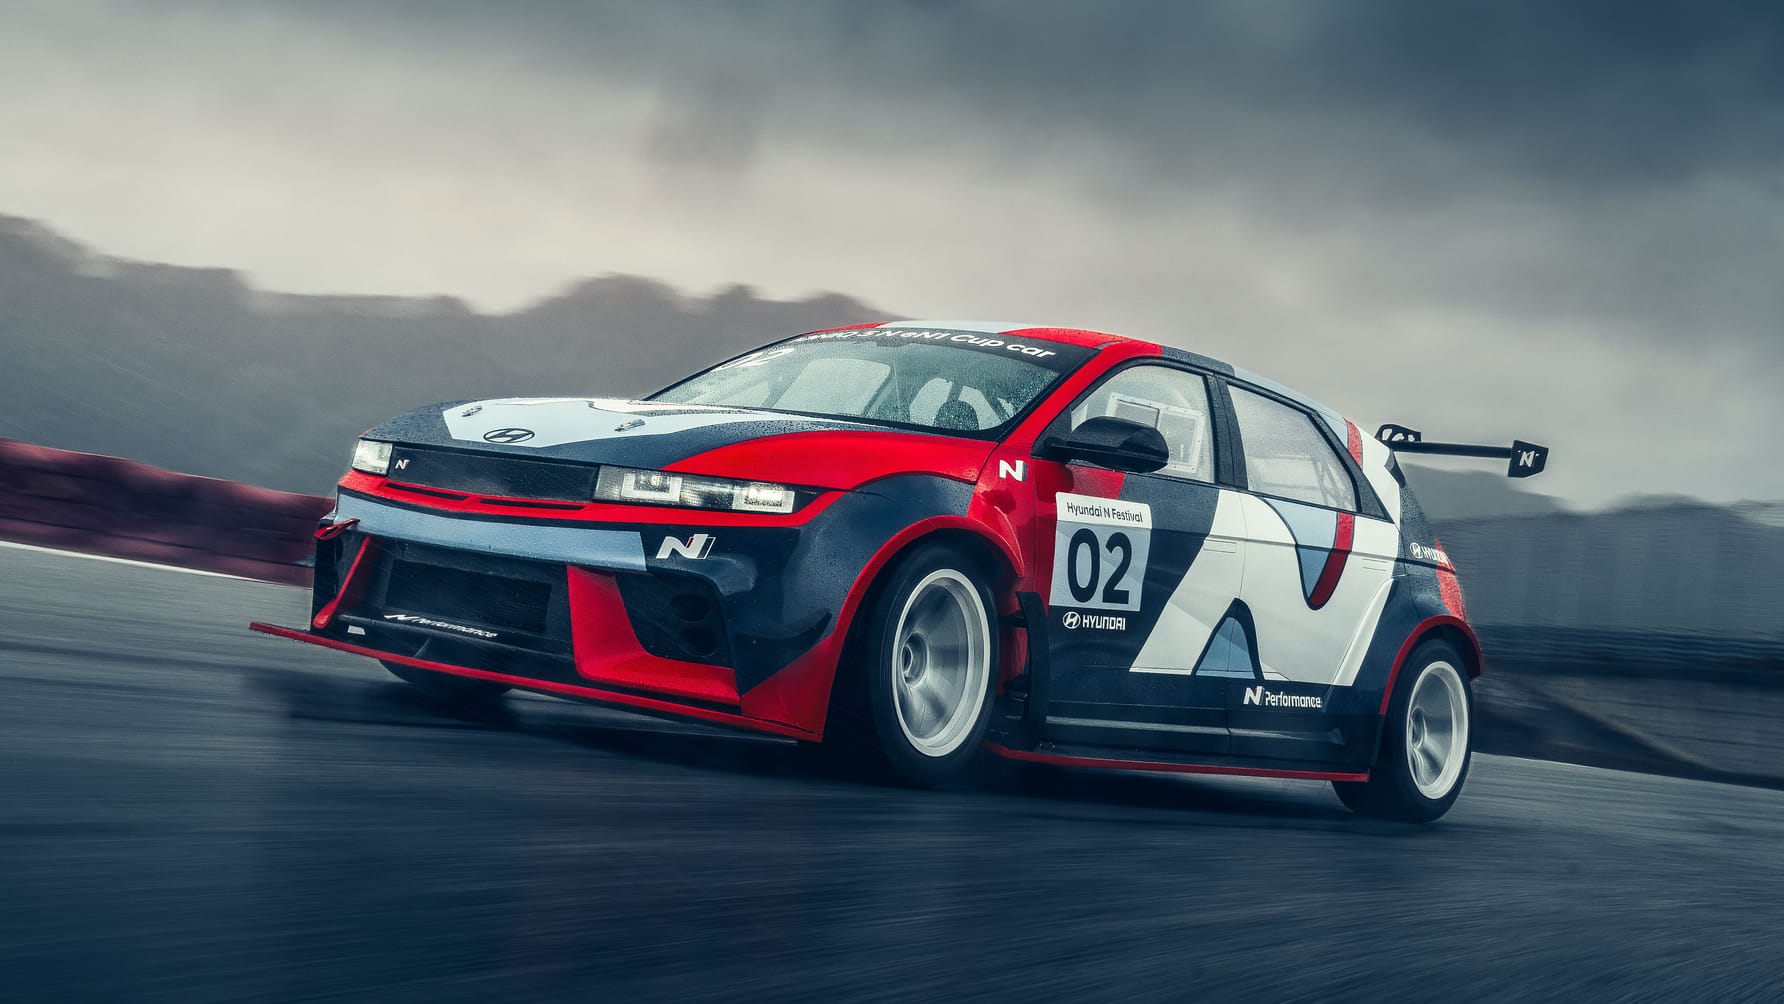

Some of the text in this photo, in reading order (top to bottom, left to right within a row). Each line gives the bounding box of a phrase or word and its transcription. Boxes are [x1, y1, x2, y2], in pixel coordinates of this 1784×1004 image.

[950, 335, 1005, 347] Cup
[1007, 344, 1057, 358] car
[999, 459, 1028, 482] N
[1066, 502, 1144, 523] Hyundai N Festival
[656, 533, 717, 560] N
[1067, 528, 1133, 605] 02
[1082, 614, 1126, 631] HYUNDAI
[1243, 685, 1322, 708] N Performance
